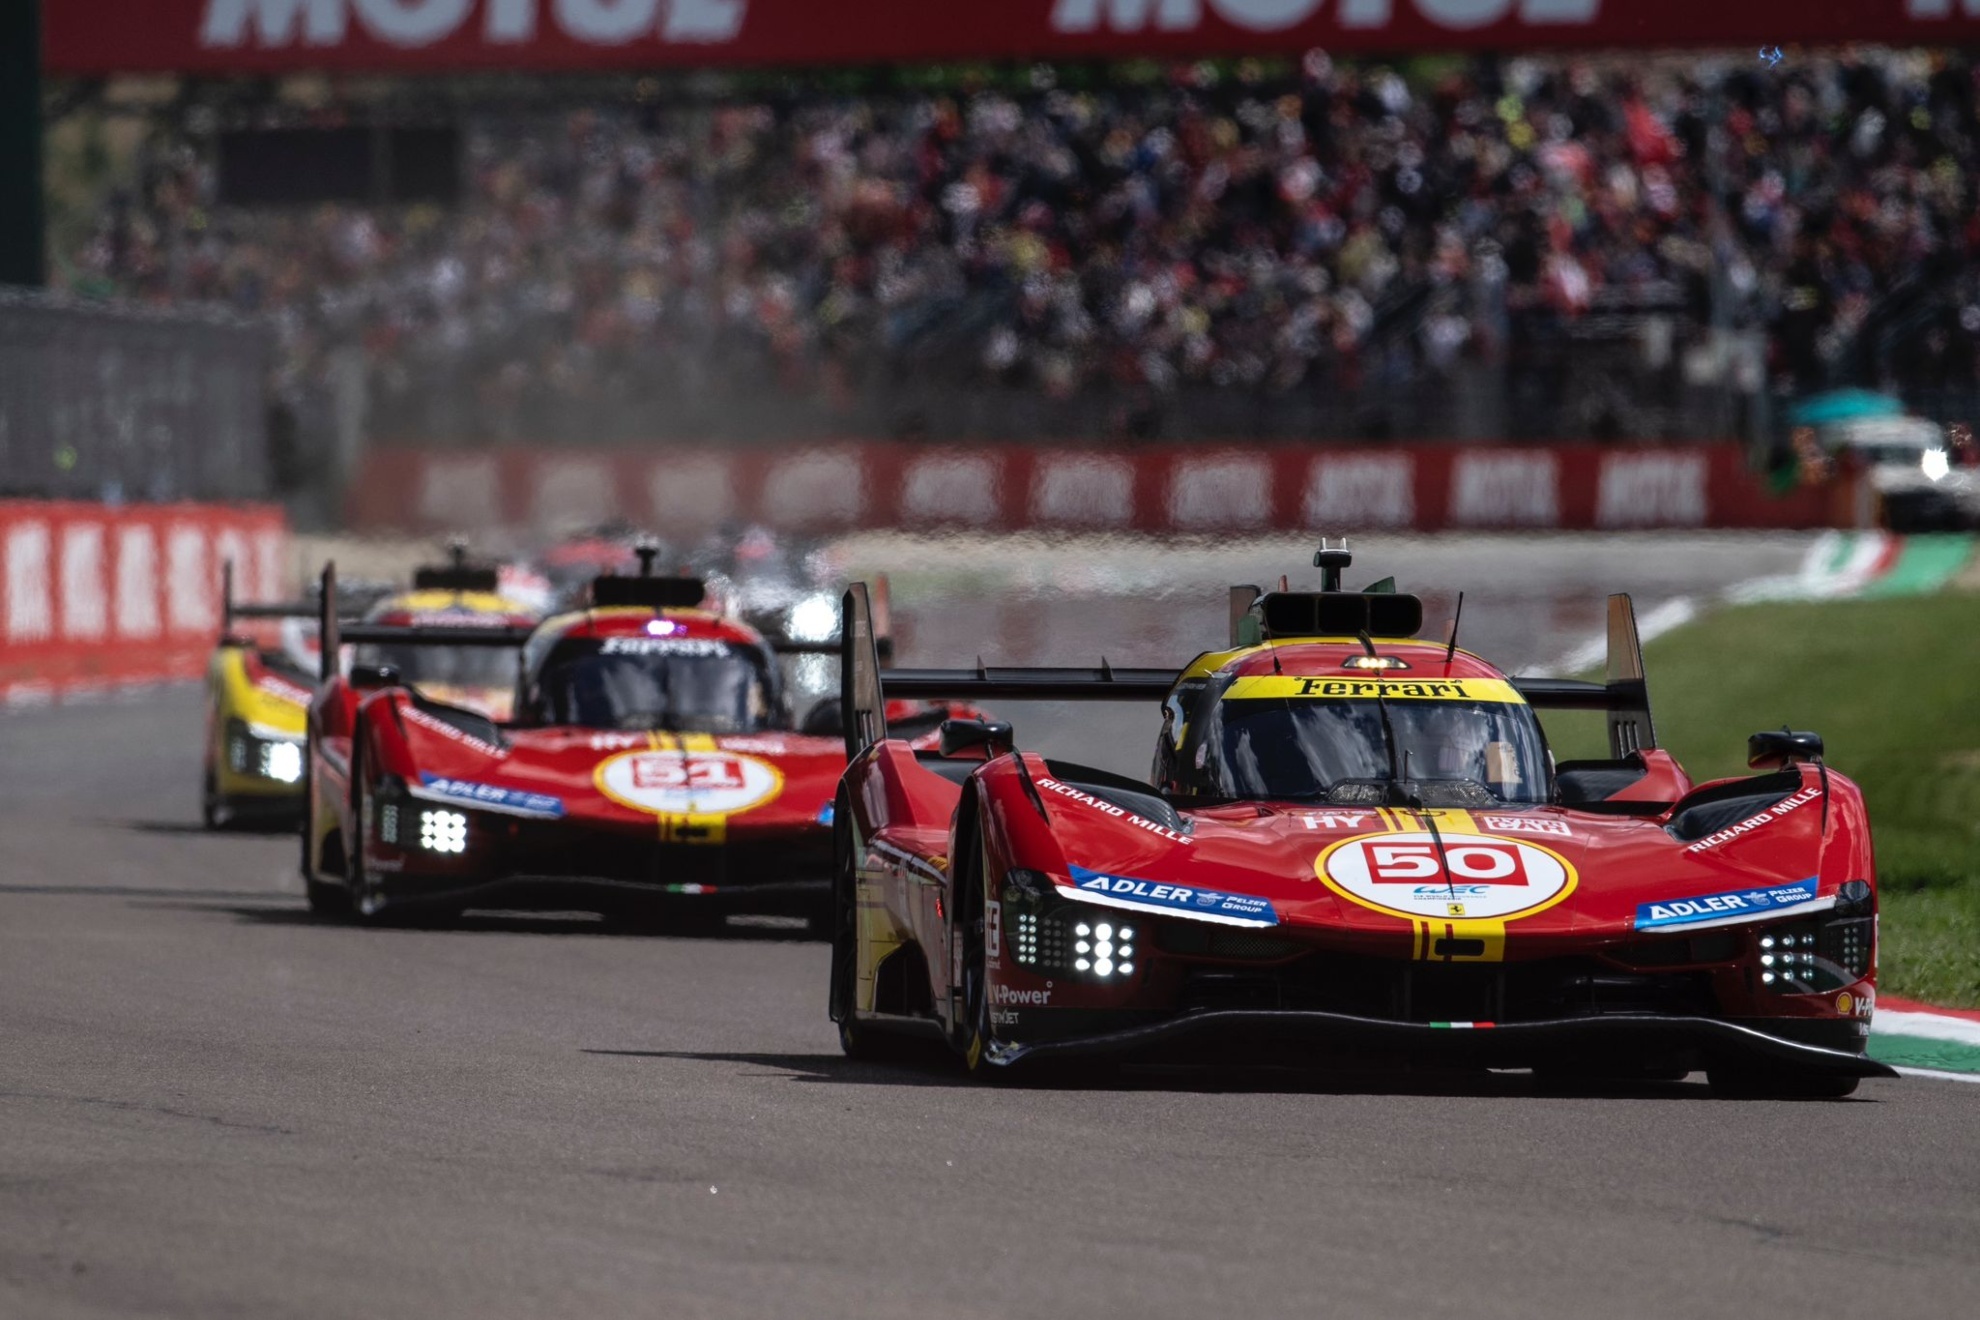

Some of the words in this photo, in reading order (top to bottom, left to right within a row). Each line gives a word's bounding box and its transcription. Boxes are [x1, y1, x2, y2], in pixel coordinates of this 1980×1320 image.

[1294, 678, 1471, 698] Ferrari
[1036, 778, 1125, 817] RICHARD
[1127, 815, 1194, 845] MILLE
[1688, 813, 1774, 853] RICHARD
[1770, 787, 1822, 816] MILLE
[1302, 815, 1365, 829] HY
[1372, 845, 1516, 879] 50
[1081, 876, 1193, 903] ADLER
[1413, 885, 1490, 894] WEC
[1768, 887, 1806, 897] PELZER
[1775, 892, 1813, 903] GROUP
[1221, 902, 1263, 913] GROUP
[1225, 896, 1268, 907] PELZER
[1649, 895, 1748, 920] ADLER
